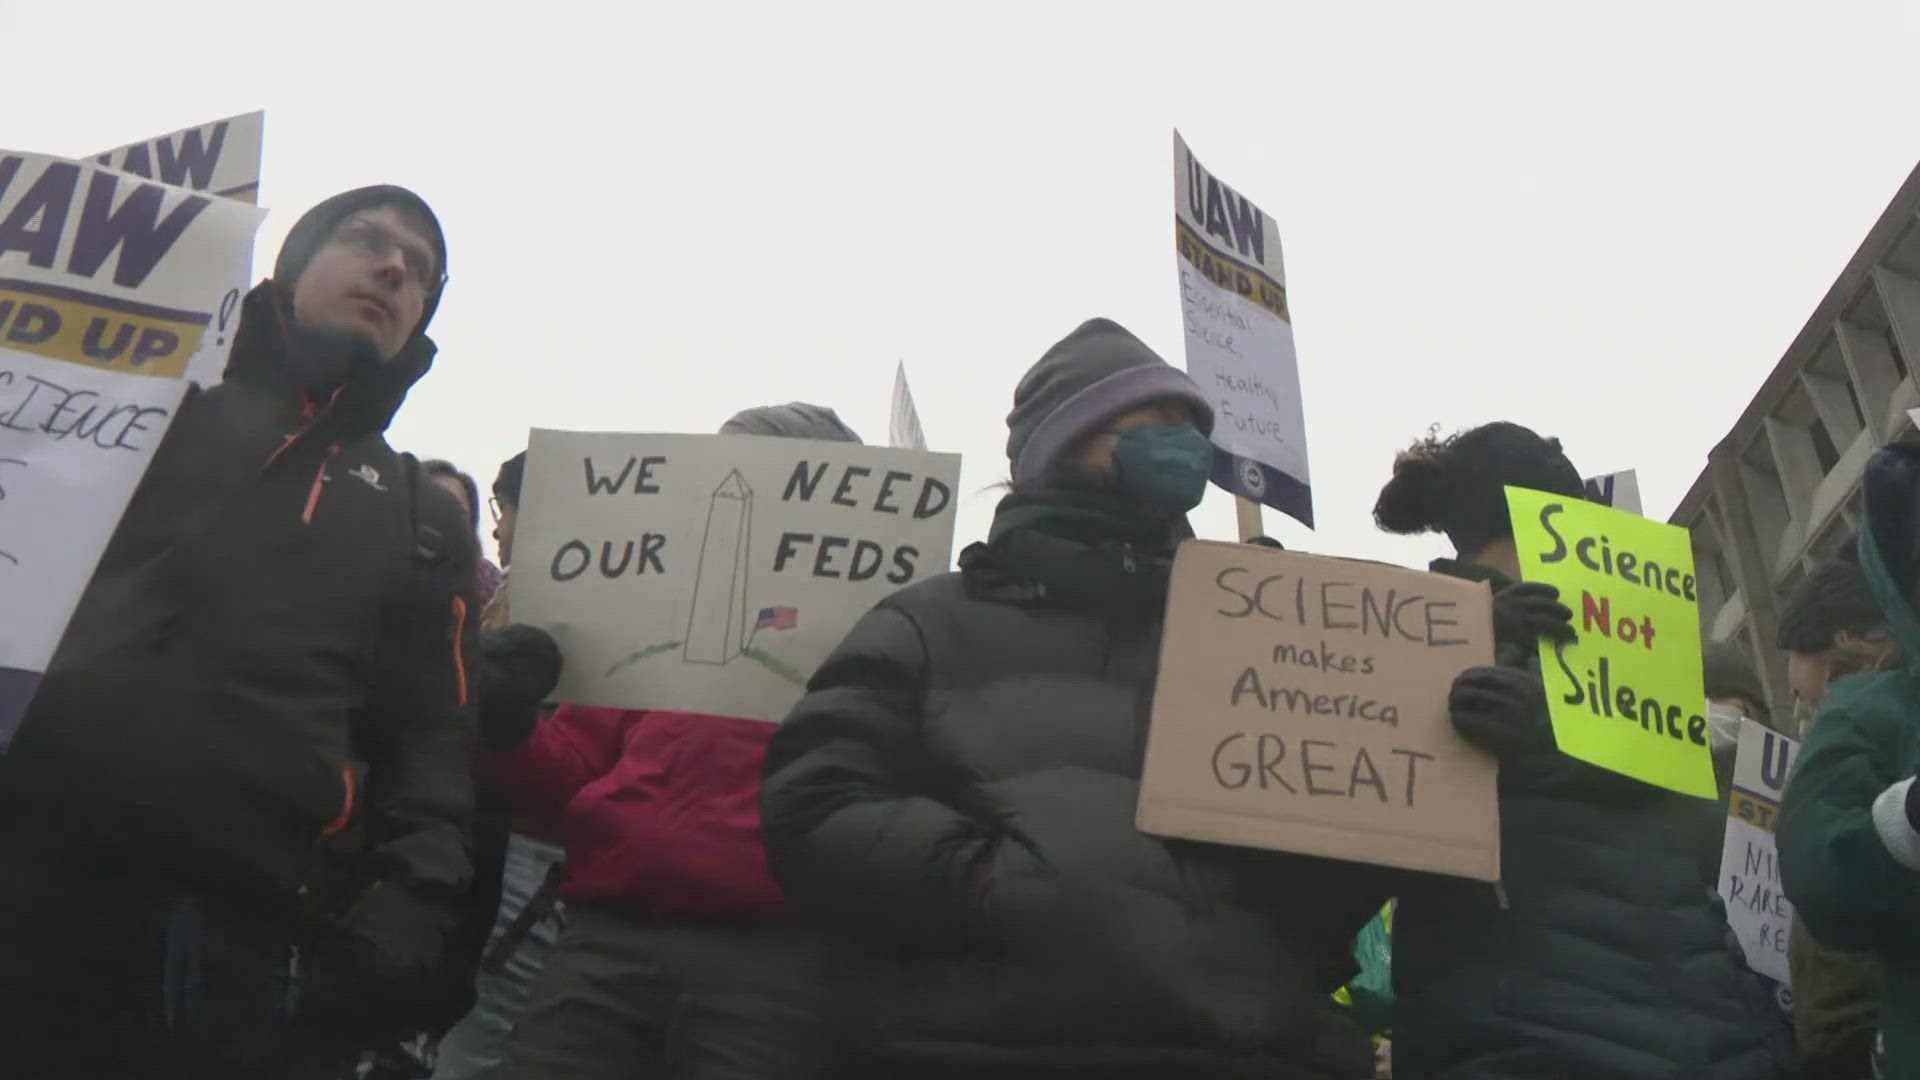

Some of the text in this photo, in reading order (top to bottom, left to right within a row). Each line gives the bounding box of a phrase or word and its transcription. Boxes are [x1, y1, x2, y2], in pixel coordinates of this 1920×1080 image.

[0, 156, 212, 289] AW
[1186, 149, 1264, 266] UAW
[1181, 233, 1252, 296] STAND
[81, 317, 179, 366] UP
[1215, 370, 1279, 412] Healthy
[1221, 399, 1284, 443] Future
[583, 456, 951, 520] WE NEED
[551, 532, 920, 585] OUR FEDS
[1539, 503, 1696, 602] Science
[1216, 567, 1469, 647] SCIENCE
[1581, 589, 1656, 650] Not
[1272, 641, 1375, 674] makes
[1230, 666, 1399, 728] America
[1555, 640, 1707, 746] Silence
[1211, 732, 1435, 808] GREAT
